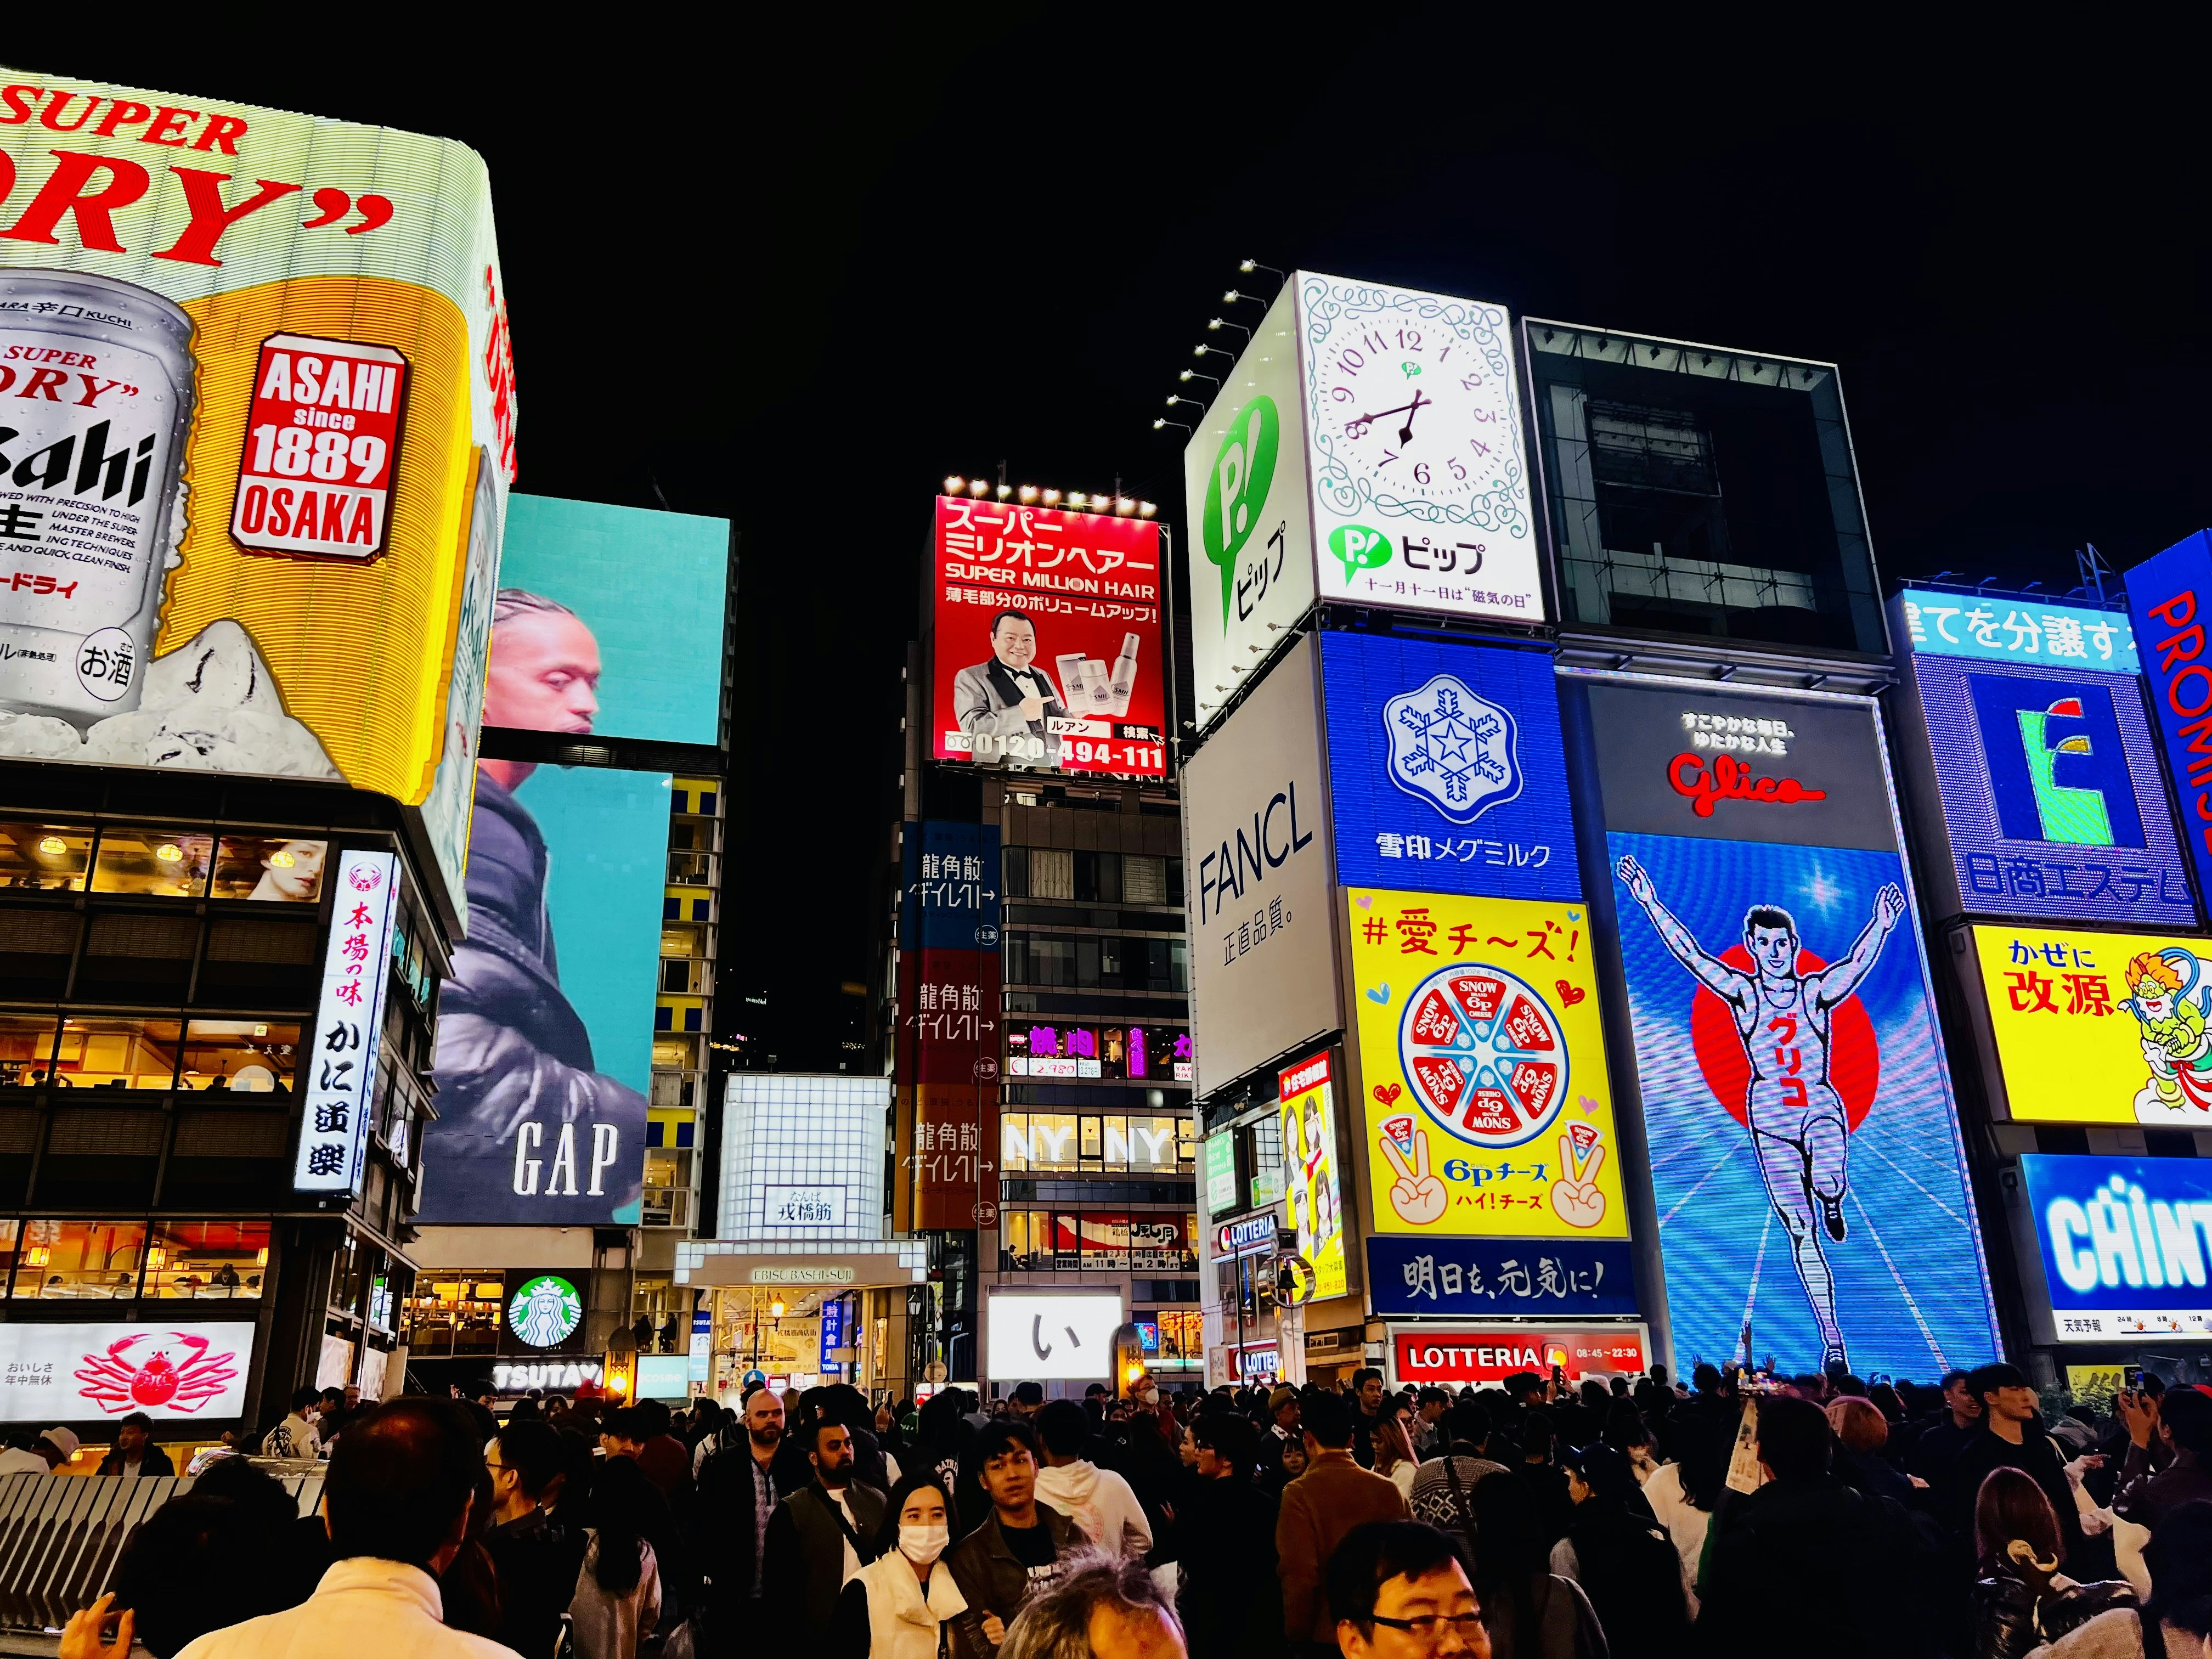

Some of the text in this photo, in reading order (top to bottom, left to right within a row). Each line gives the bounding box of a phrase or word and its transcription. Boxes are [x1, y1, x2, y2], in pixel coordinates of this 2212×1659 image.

[0, 84, 248, 156] SUPER
[32, 302, 83, 318] 辛口
[86, 310, 132, 328] KUCHI
[1363, 330, 1389, 354] 11
[1395, 330, 1423, 352] 12
[1438, 346, 1451, 363] 1
[3, 346, 97, 370] SUPER
[1336, 348, 1364, 377] 10
[260, 353, 397, 415] ASAHI
[1331, 386, 1355, 403] 9
[1460, 373, 1482, 391] 2
[294, 407, 356, 432] since
[1474, 408, 1496, 424] 3
[1344, 422, 1368, 441] 8
[252, 424, 386, 486] 1889
[1378, 449, 1400, 469] 7
[1469, 439, 1491, 459] 4
[1414, 463, 1431, 484] 6
[1447, 457, 1466, 480] 5
[26, 493, 54, 504] WITH
[57, 498, 108, 514] PRECISION
[109, 509, 120, 518] TO
[121, 512, 140, 524] HIGH
[52, 510, 89, 523] UNDER
[92, 517, 111, 528] THE
[240, 484, 374, 546] OSAKA
[946, 504, 1063, 538] スーパー
[49, 522, 94, 538] MASTER
[4, 544, 32, 552] AND
[72, 552, 105, 566] CLEAN
[46, 535, 133, 560] ING TECHNIQUES
[946, 532, 1154, 574] ミリオンヘアー
[1402, 535, 1486, 575] ピップ
[945, 562, 1155, 600] SUPER MILLION HAIR
[1237, 520, 1286, 623] ピップ
[945, 586, 1157, 624] 薄毛部分のボリュームアップ!
[1365, 578, 1531, 609] 十一月十一日は“磁気の日”
[1906, 601, 2137, 661] てを分譲す
[81, 646, 133, 687] お酒
[1115, 687, 1129, 696] SMH
[1051, 719, 1090, 732] ルアン
[1123, 725, 1149, 740] 検索
[1682, 712, 1796, 738] すこやかな毎日、
[975, 736, 1163, 769] 0120-494-111
[1694, 731, 1788, 756] ゆたかな人生
[1667, 752, 1827, 817] Glico
[1200, 780, 1312, 926] FANCL
[1375, 832, 1551, 868] 雪印メグミルク
[922, 853, 984, 881] 龍角散
[1963, 852, 2194, 907] 日商エステム
[908, 882, 995, 909] ダイレクト
[1223, 894, 1292, 967] 正直品質。
[335, 901, 373, 1007] 本場の味
[2007, 939, 2096, 968] かぜに
[919, 983, 984, 1012] 龍角散
[1459, 980, 1498, 994] SNOW
[2003, 970, 2115, 1017] 改源
[905, 1013, 995, 1041] ダイレクト
[1416, 996, 1439, 1036] SNOW
[1520, 1004, 1550, 1042] SNOW
[1029, 1025, 1093, 1056] 焼肉
[1444, 1020, 1458, 1044] CHEESE
[1505, 1023, 1523, 1048] CHEESE
[1446, 1059, 1463, 1085] CHEESE
[1767, 1011, 1809, 1108] グリコ
[1418, 1065, 1449, 1105] SNOW
[1511, 1063, 1526, 1087] CHEESE
[1531, 1070, 1553, 1112] SNOW
[914, 1121, 982, 1151] 龍角散
[1389, 1119, 1408, 1130] SNOW
[1472, 1116, 1511, 1129] SNOW
[1005, 1124, 1171, 1164] NY NY
[512, 1121, 619, 1197] GAP
[901, 1155, 994, 1183] ダイレクト
[790, 1190, 821, 1202] なんば
[1456, 1192, 1543, 1210] ハイ!チーズ
[778, 1202, 832, 1221] 戎橋筋
[1131, 1221, 1176, 1245] 風月
[1231, 1214, 1276, 1246] LOTTERIA
[754, 1269, 853, 1282] EBISU BASHI-SUJI
[1402, 1254, 1604, 1301] 明日を、元気に!
[1031, 1313, 1082, 1361] い
[2063, 1319, 2102, 1333] 天気予報
[7, 1362, 54, 1374] おいしさ
[1409, 1347, 1541, 1368] LOTTERIA
[4, 1373, 53, 1387] 年中無休
